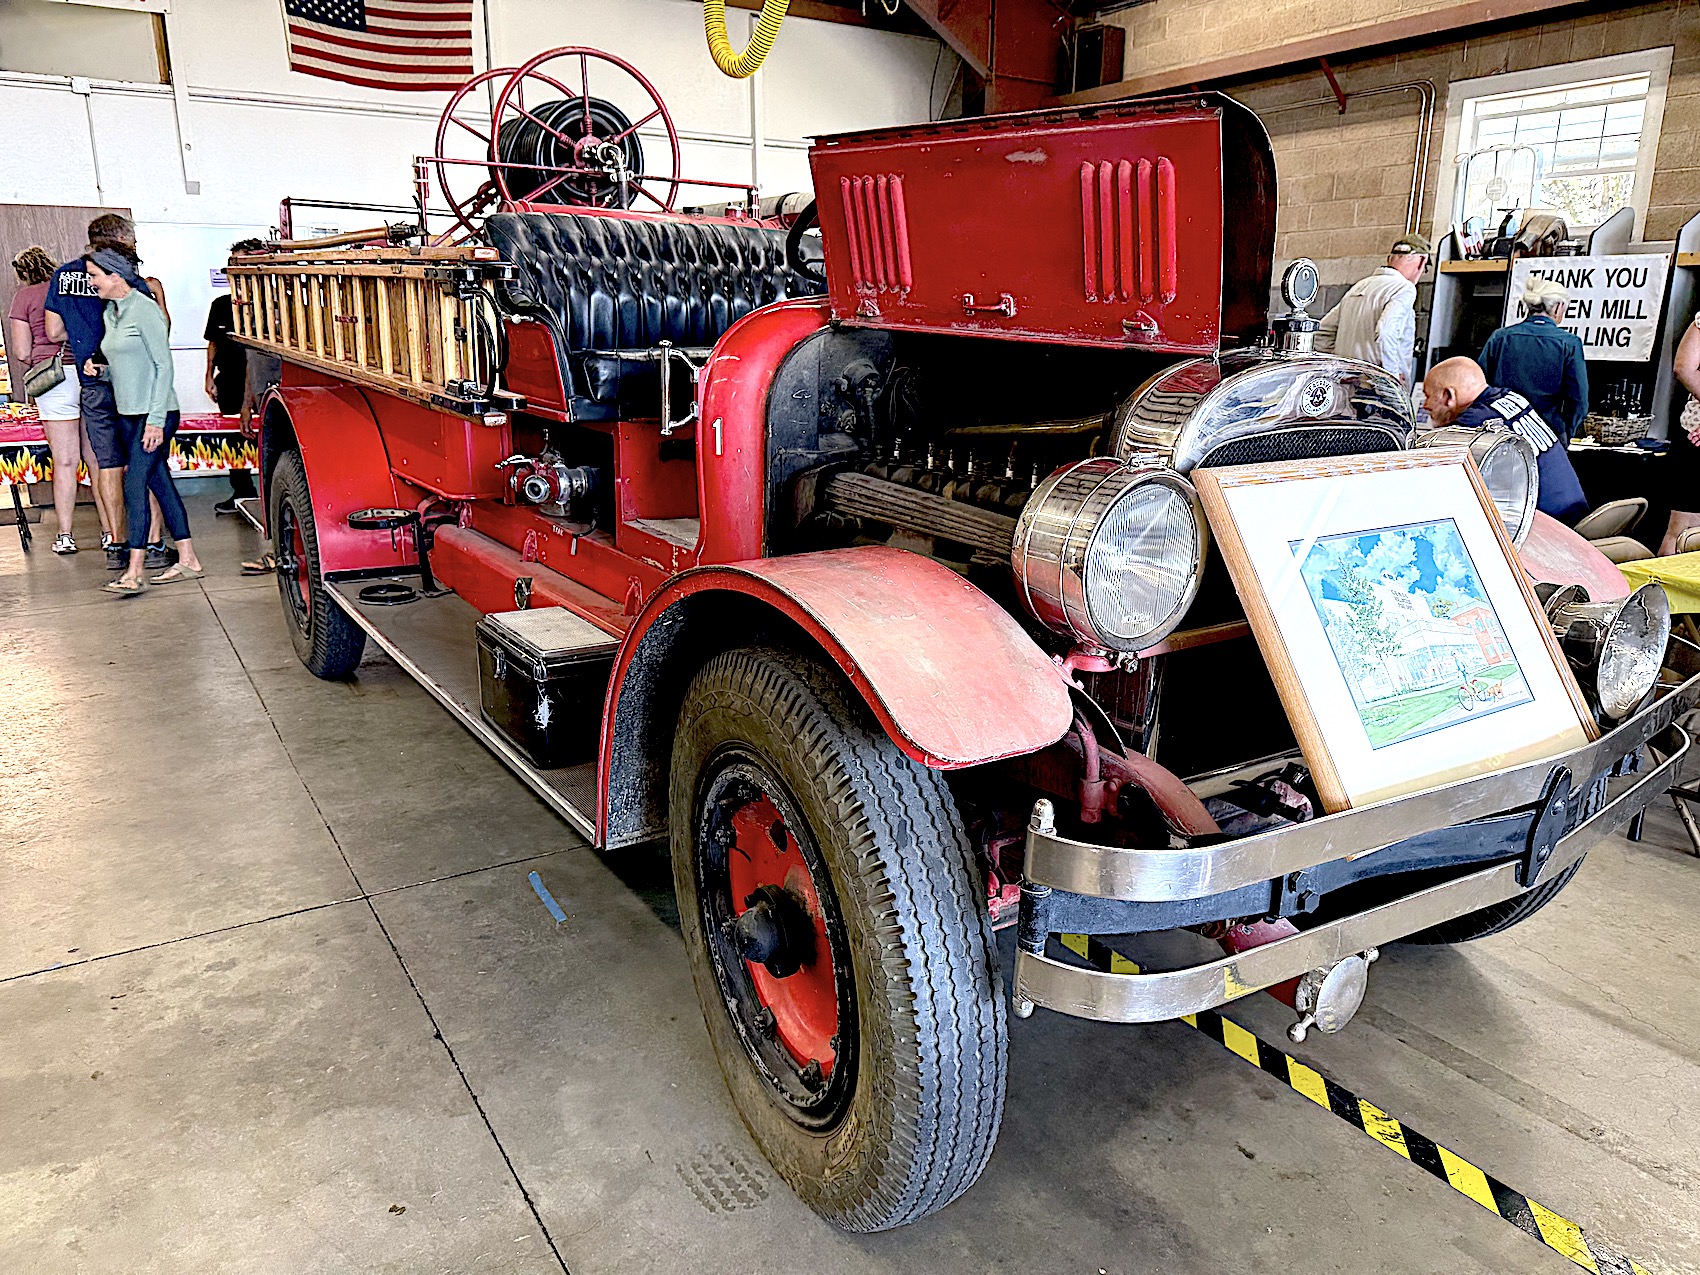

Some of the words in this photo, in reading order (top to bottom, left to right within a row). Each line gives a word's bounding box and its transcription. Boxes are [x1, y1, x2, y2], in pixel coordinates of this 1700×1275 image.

[1605, 267, 1648, 288] YOU
[1600, 299, 1648, 320] MILL
[712, 417, 723, 455] 1
